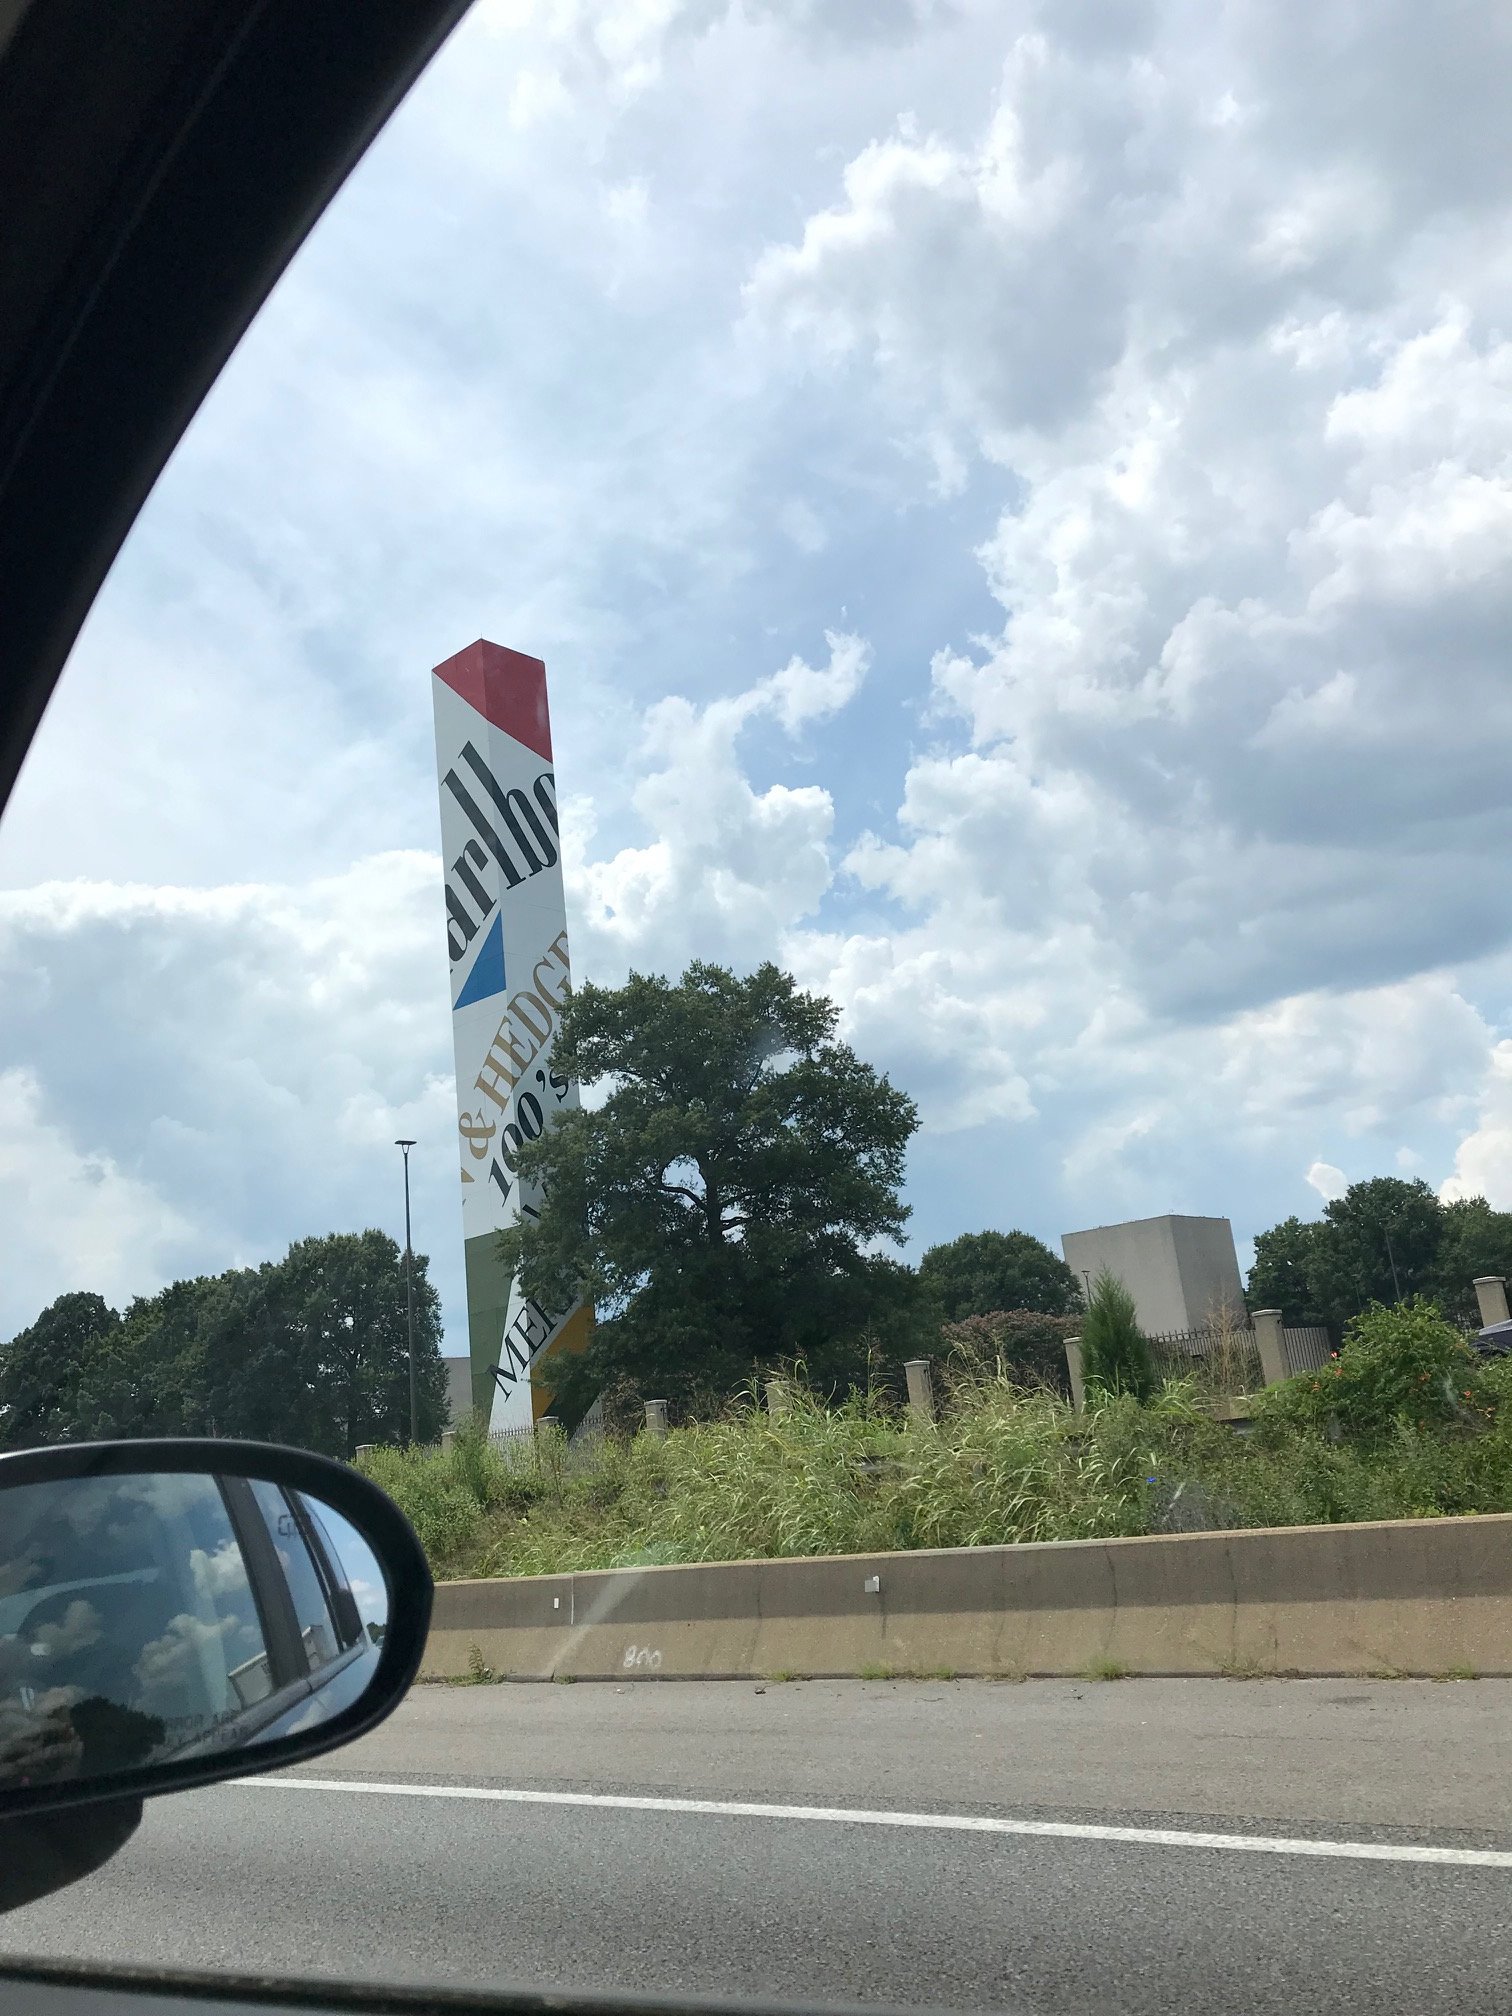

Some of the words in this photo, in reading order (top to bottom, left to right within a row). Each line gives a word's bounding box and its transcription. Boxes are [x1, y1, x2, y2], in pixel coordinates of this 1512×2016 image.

[440, 740, 559, 973] arlbo
[458, 1107, 497, 1160] &
[487, 1069, 569, 1207] 100's
